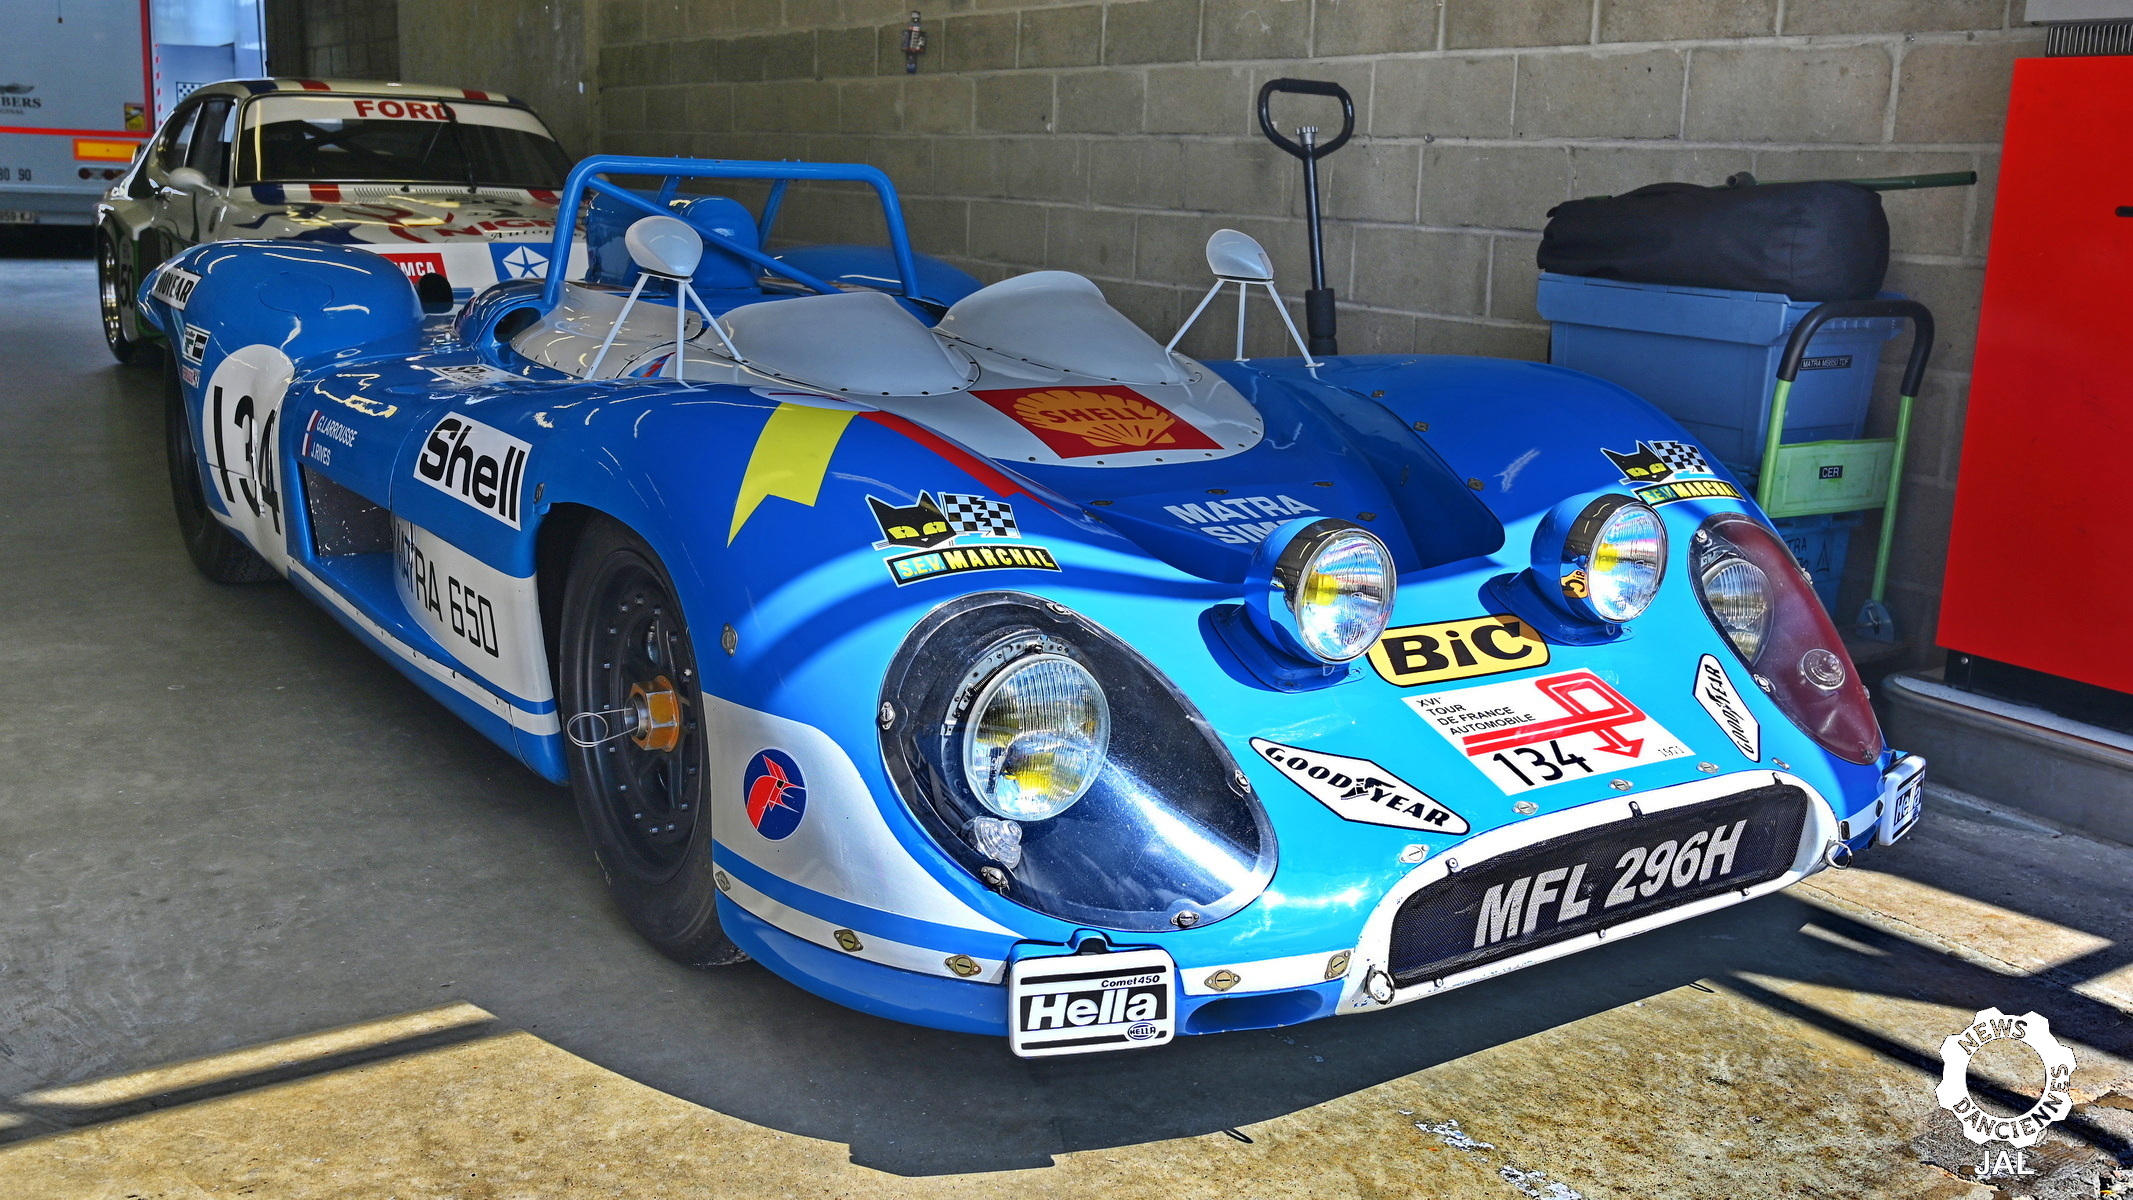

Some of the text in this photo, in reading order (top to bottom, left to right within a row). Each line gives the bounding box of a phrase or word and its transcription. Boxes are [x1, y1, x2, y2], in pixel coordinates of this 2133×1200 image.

[353, 100, 456, 120] FORD
[394, 262, 436, 276] MCA
[1803, 359, 1821, 368] MATRA
[1038, 407, 1155, 424] SHELL
[213, 385, 281, 535] 134
[419, 418, 526, 523] Shell
[1822, 467, 1840, 478] CER
[1670, 481, 1741, 498] MARCHAL
[1163, 494, 1321, 525] MATRA
[1201, 518, 1297, 544] SIM
[1786, 537, 1807, 553] TRA
[897, 549, 1055, 578] S.E.V. MARCHAL
[448, 575, 500, 659] 650
[1381, 621, 1533, 676] BiC
[1426, 704, 1467, 716] TOUR
[1437, 706, 1515, 726] DE FRANCE
[1450, 714, 1537, 735] AUTOMOBILE
[1493, 739, 1594, 787] 134
[1895, 784, 1922, 824] Hella
[1474, 819, 1748, 949] MFL 296H
[1027, 988, 1158, 1031] Hella
[1129, 1024, 1156, 1037] HELLA
